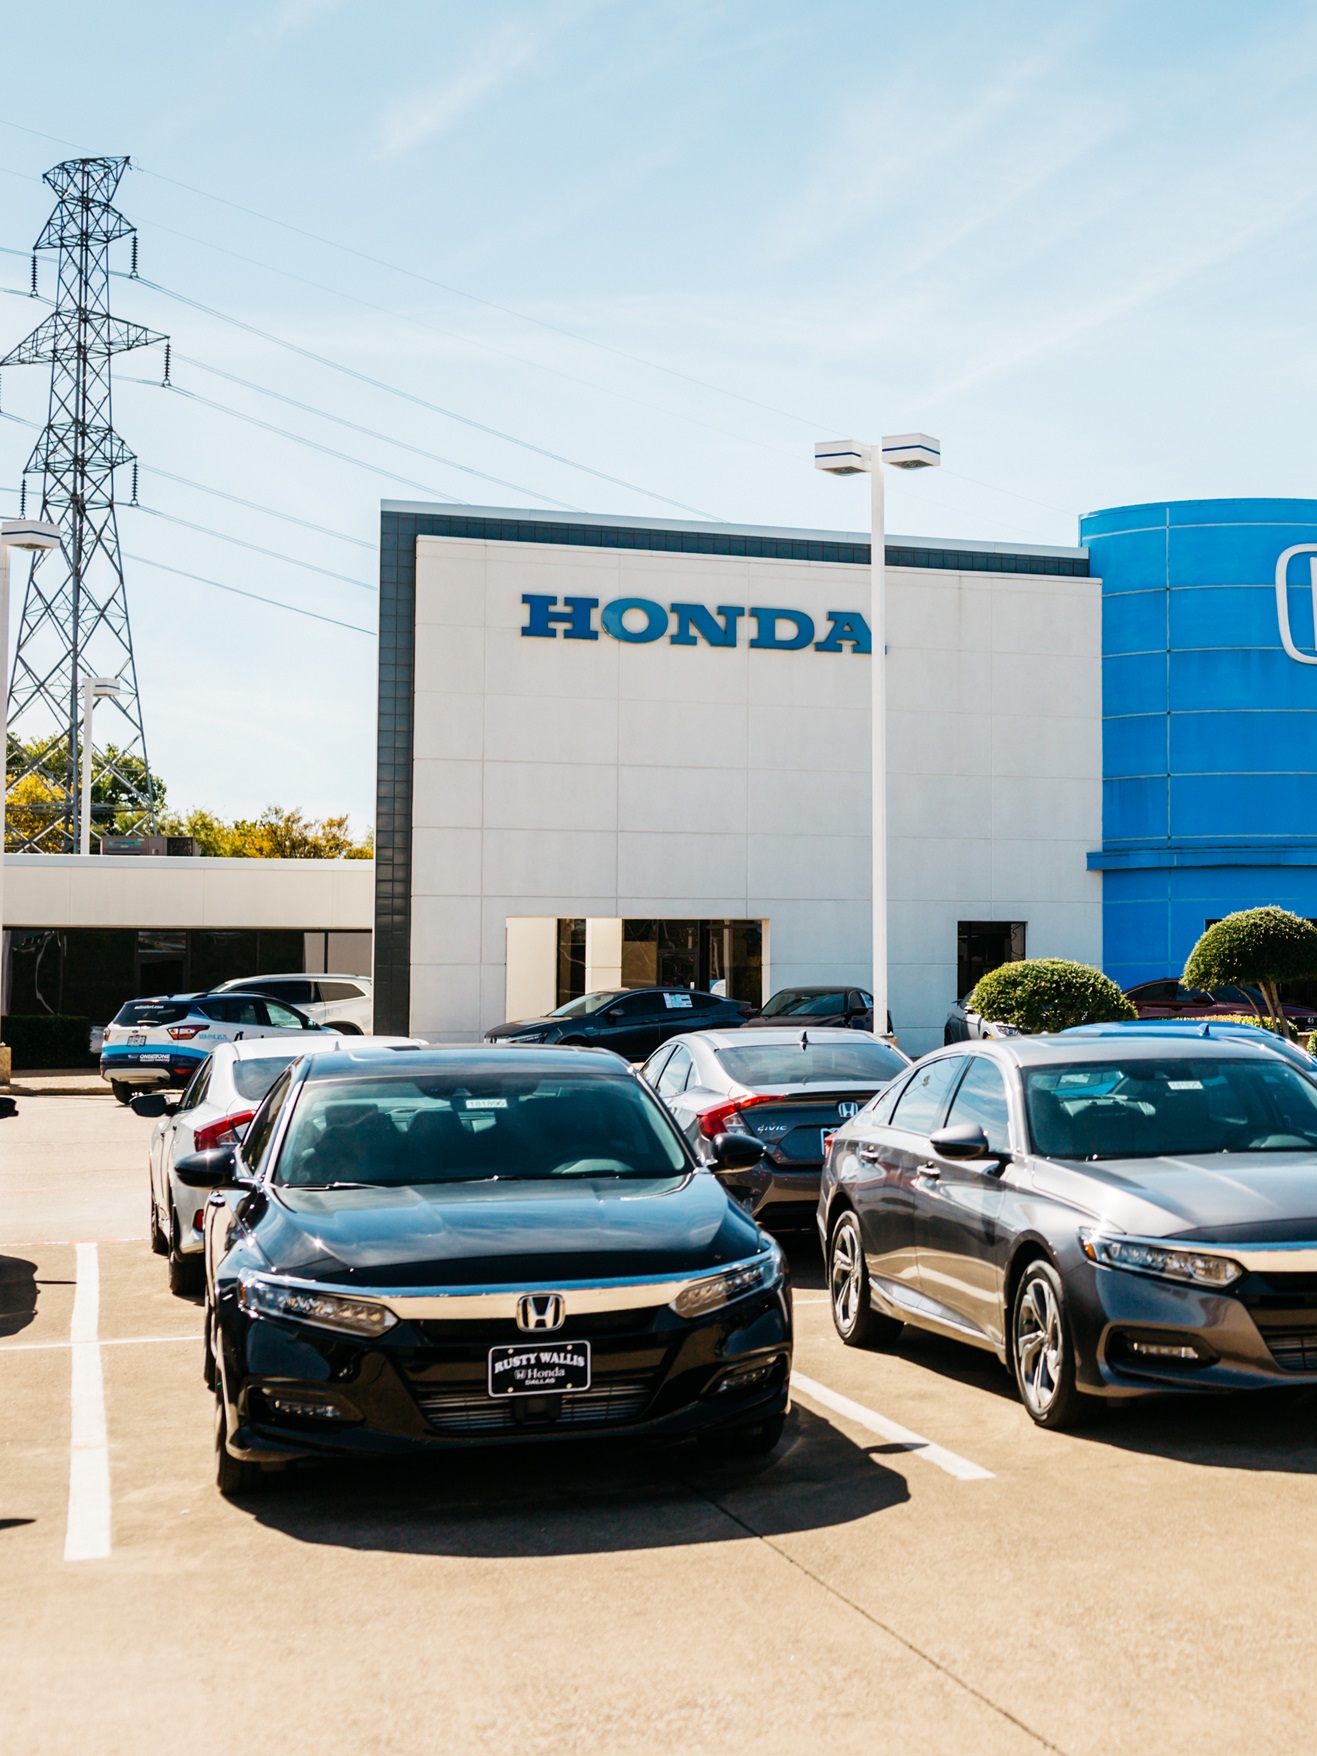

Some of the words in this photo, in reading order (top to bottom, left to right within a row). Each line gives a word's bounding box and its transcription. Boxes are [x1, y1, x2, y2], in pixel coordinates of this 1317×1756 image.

[521, 593, 887, 655] HONDA
[757, 1123, 788, 1134] CIVIC
[494, 1352, 539, 1374] RUSTY
[539, 1352, 585, 1367] WALLIS
[527, 1367, 565, 1379] Honda
